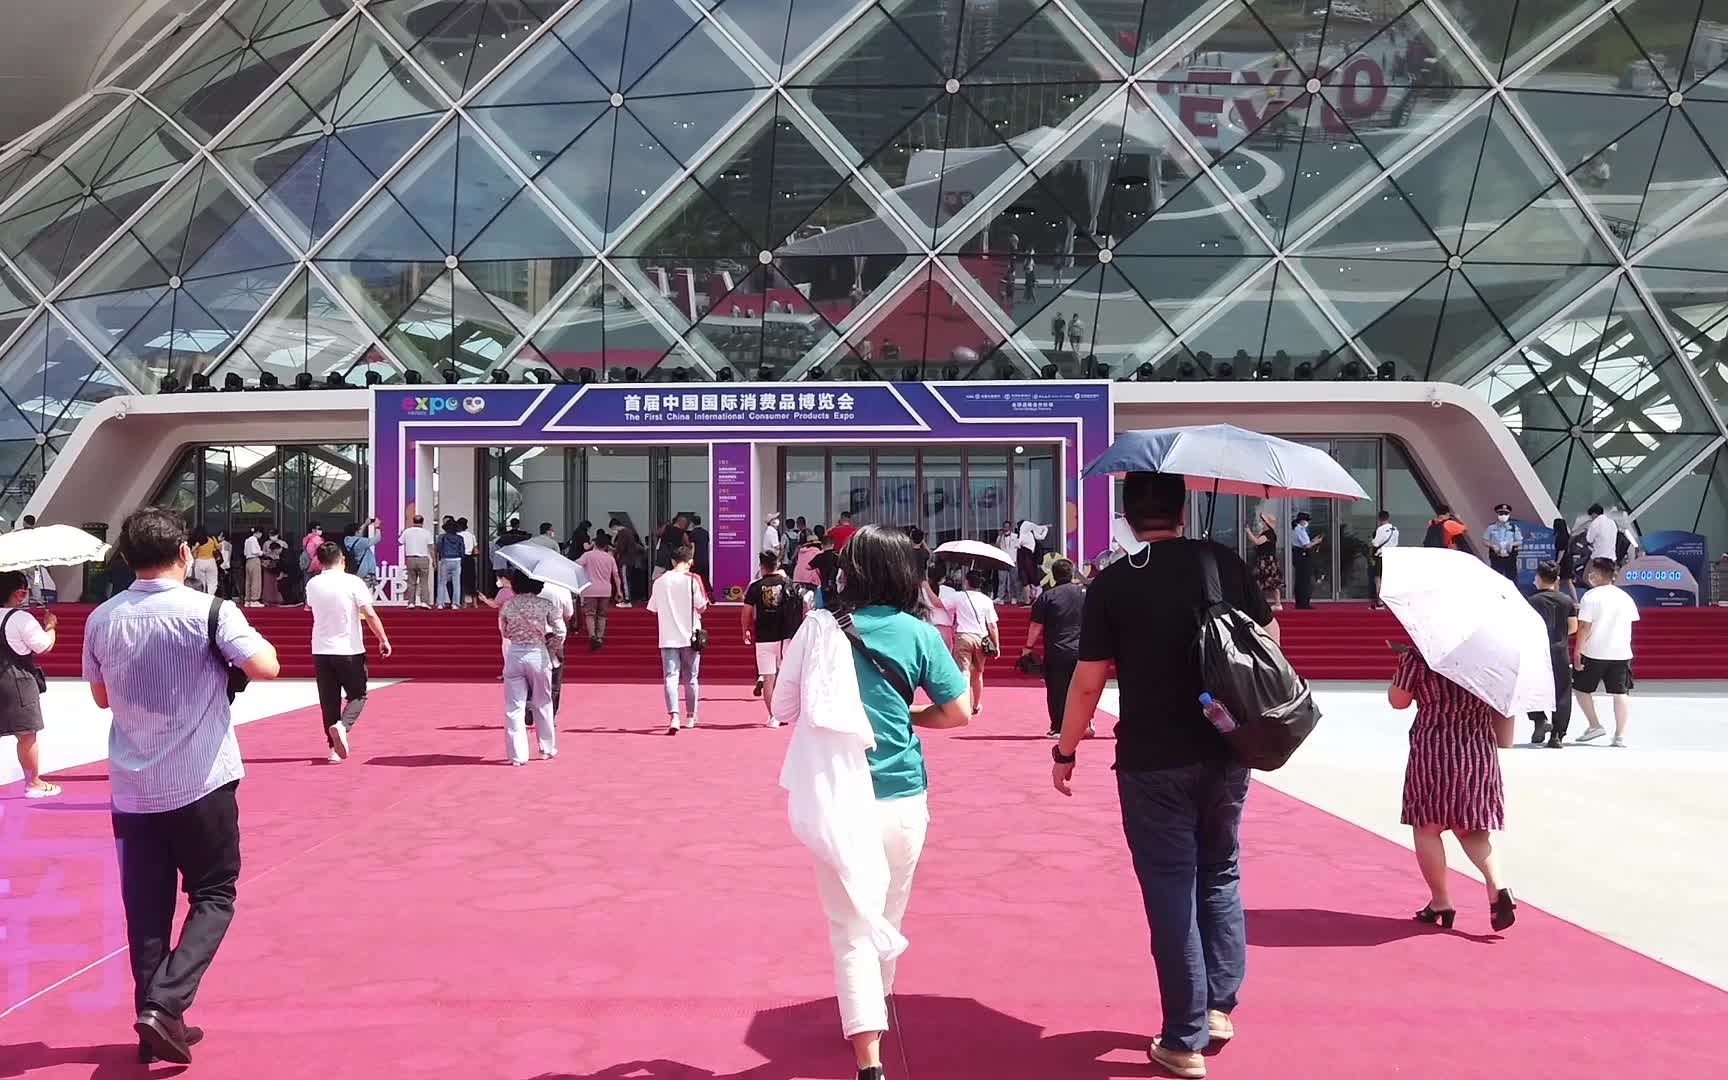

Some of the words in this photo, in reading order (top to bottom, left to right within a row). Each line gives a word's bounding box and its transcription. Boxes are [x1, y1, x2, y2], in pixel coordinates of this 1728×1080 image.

[624, 392, 855, 412] 首届中国国际消费品博览会
[624, 413, 640, 421] The
[644, 413, 663, 421] First
[666, 413, 690, 421] China
[694, 413, 745, 421] International
[749, 412, 790, 420] Consumer
[794, 412, 829, 420] Products
[833, 412, 855, 421] Expo
